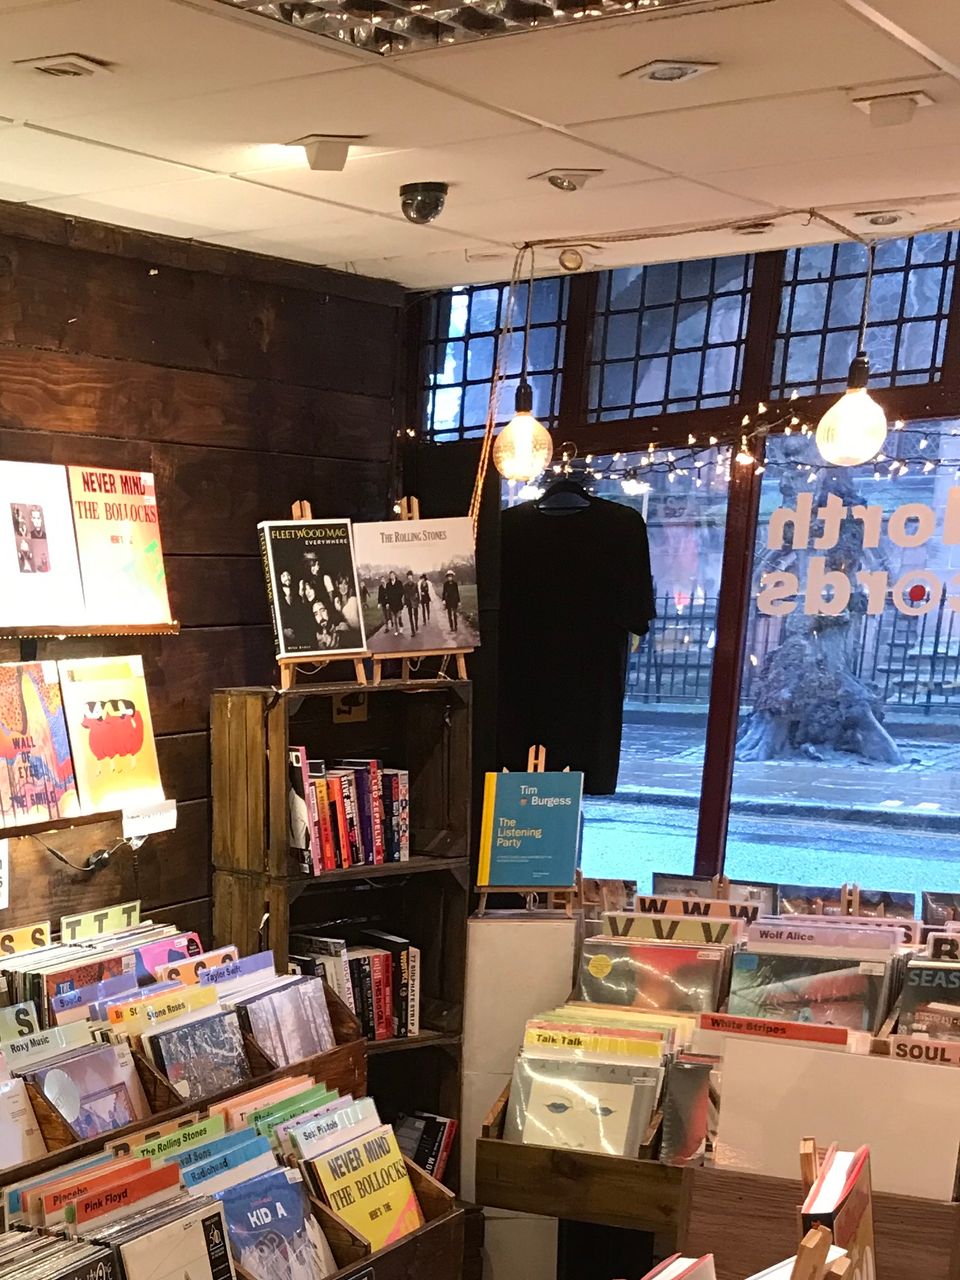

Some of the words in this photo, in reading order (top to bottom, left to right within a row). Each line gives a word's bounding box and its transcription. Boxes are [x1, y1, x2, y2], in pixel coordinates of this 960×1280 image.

[81, 471, 117, 494] NEVER
[75, 500, 100, 520] THE
[104, 502, 157, 523] BOLLOCKS
[271, 527, 325, 540] FLEETWOOD
[326, 527, 347, 538] MAC
[305, 538, 348, 546] EVERYWHERE
[380, 531, 393, 544] THE
[394, 530, 422, 543] ROLLING
[423, 530, 447, 542] STONES
[12, 737, 36, 749] WALL
[21, 751, 31, 764] OF
[341, 775, 351, 799] STEVE
[371, 779, 379, 798] LED
[520, 785, 538, 795] Tim
[531, 796, 572, 807] Burgess
[373, 799, 381, 846] ZEPPELIN
[498, 817, 516, 827] The
[497, 828, 542, 839] Listening
[496, 838, 521, 849] Party
[65, 919, 81, 940] T
[94, 912, 109, 934] T
[122, 904, 137, 927] T
[758, 929, 783, 941] Wolf
[786, 930, 815, 942] Alice
[206, 970, 226, 983] Taylor
[57, 980, 71, 995] THE
[167, 1001, 186, 1014] Roses
[14, 1007, 34, 1037] S
[710, 1018, 742, 1031] White
[745, 1021, 787, 1035] Stripes
[10, 1040, 29, 1054] Roxy
[29, 1034, 50, 1047] Music
[536, 1033, 558, 1044] Talk
[561, 1035, 583, 1047] Talk
[896, 1043, 952, 1063] SOUL
[140, 1144, 155, 1157] The
[156, 1136, 182, 1156] Rolling
[182, 1126, 208, 1145] Stones
[327, 1147, 364, 1182] NEVER
[363, 1135, 391, 1163] MIND
[190, 1157, 228, 1182] Radiohead
[329, 1185, 357, 1212] THE
[355, 1157, 408, 1200] BOLLOCKS
[84, 1198, 103, 1213] Pink
[104, 1188, 129, 1206] Floyd
[247, 1207, 272, 1229] KID
[277, 1201, 287, 1218] A
